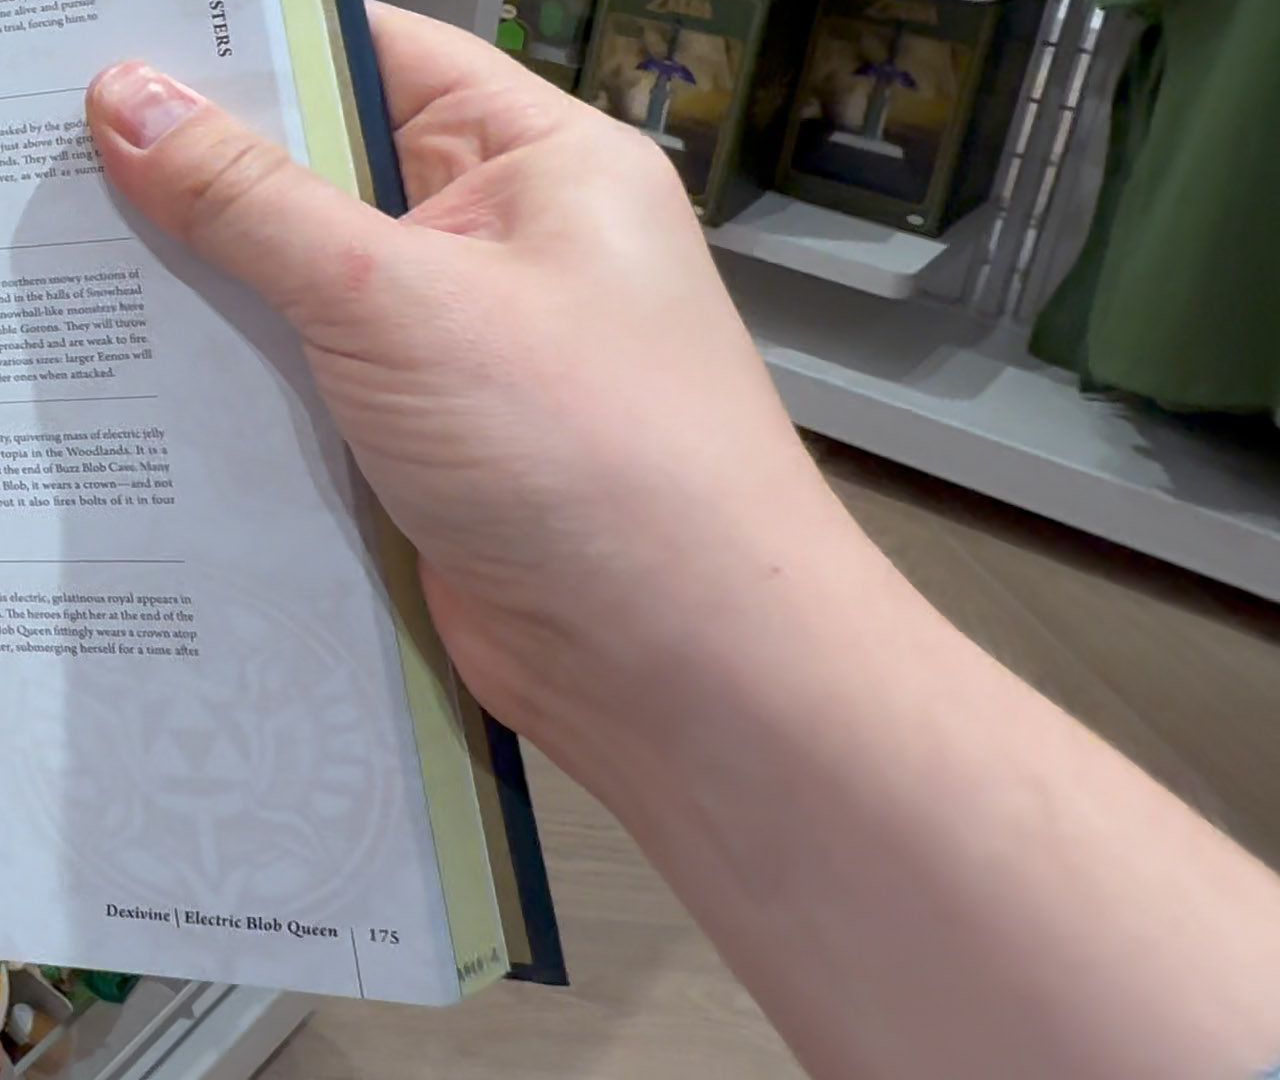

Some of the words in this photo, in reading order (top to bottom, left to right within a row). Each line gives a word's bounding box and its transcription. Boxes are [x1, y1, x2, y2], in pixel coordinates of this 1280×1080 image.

[51, 593, 105, 605] gelatinous
[107, 593, 134, 605] royal
[136, 596, 178, 607] appears
[180, 596, 191, 604] in
[106, 903, 170, 921] Dexivine
[184, 910, 241, 928] Electric
[246, 916, 282, 931] Blob
[287, 920, 337, 938] Queen
[369, 928, 399, 944] 175
